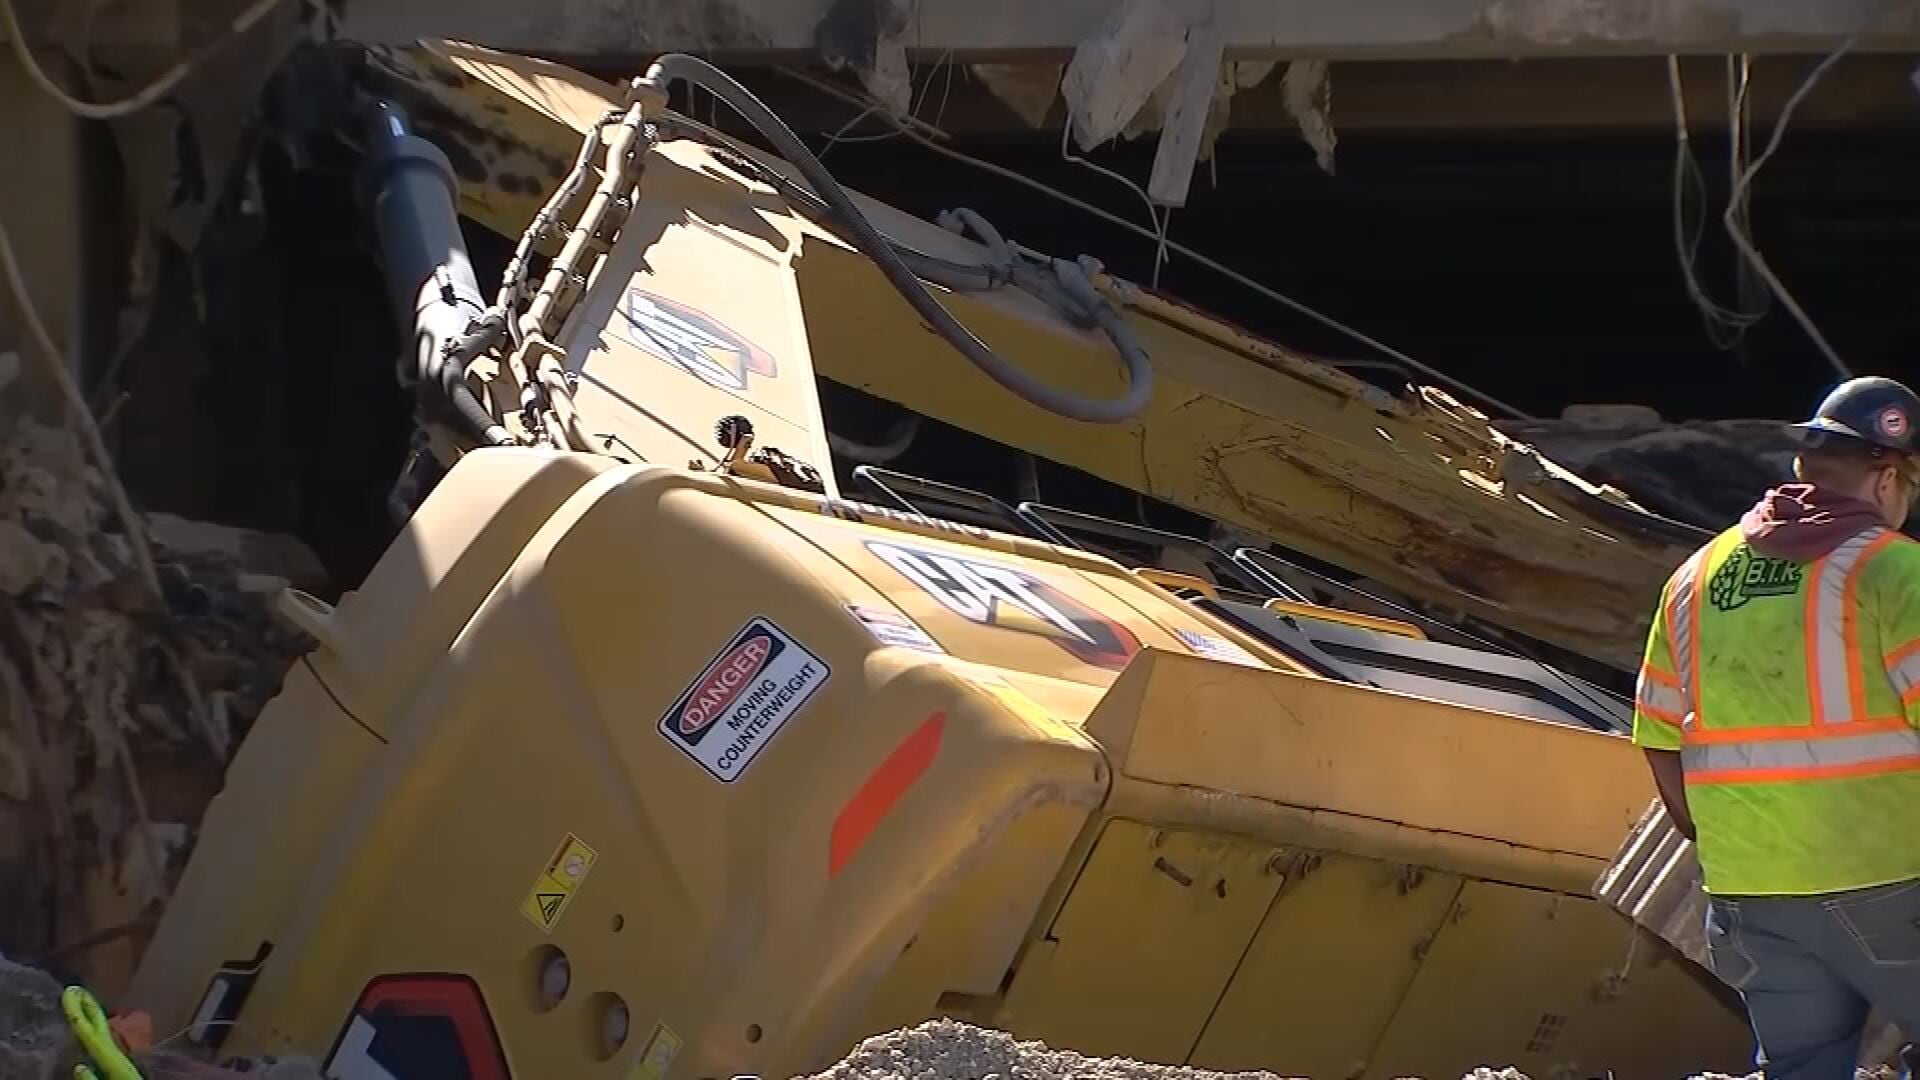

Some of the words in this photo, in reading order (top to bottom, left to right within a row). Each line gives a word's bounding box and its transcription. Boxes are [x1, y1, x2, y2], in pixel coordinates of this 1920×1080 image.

[865, 541, 1097, 645] CAT
[684, 643, 766, 727] DANGER
[717, 662, 817, 770] COUNTERWEIGHT
[726, 679, 777, 731] MOVING
